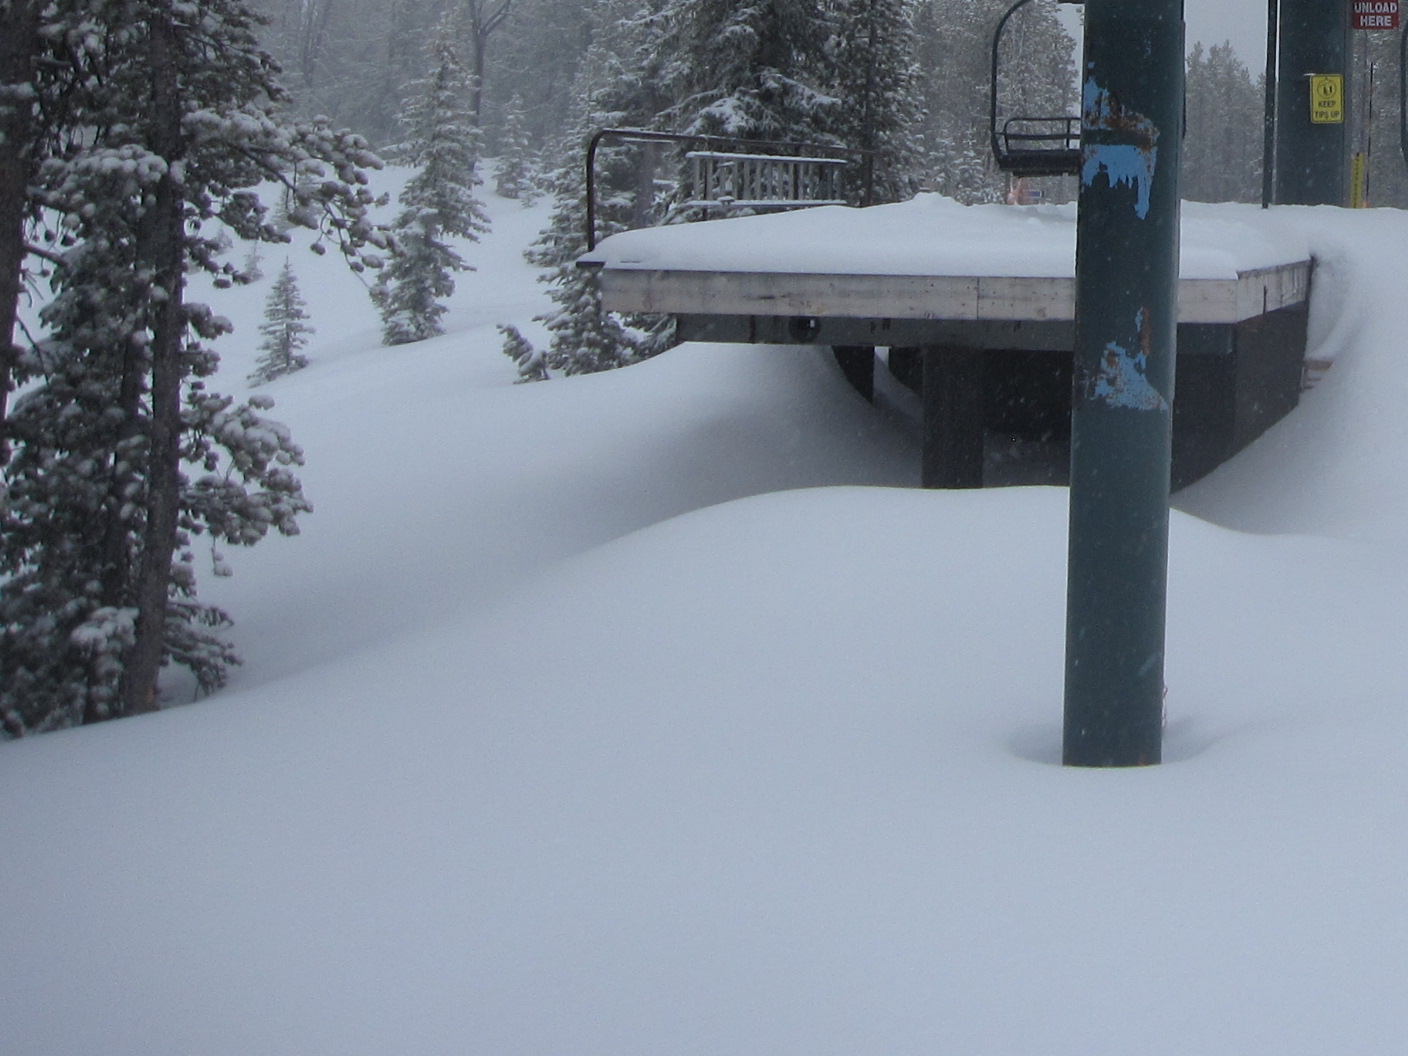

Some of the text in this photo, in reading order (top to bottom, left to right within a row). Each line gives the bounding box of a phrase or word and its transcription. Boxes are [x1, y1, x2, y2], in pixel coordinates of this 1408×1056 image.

[1354, 1, 1397, 13] UNLOAD
[1360, 15, 1392, 26] HERE
[1317, 100, 1337, 108] KEEP
[1314, 110, 1341, 120] TIPS UP
